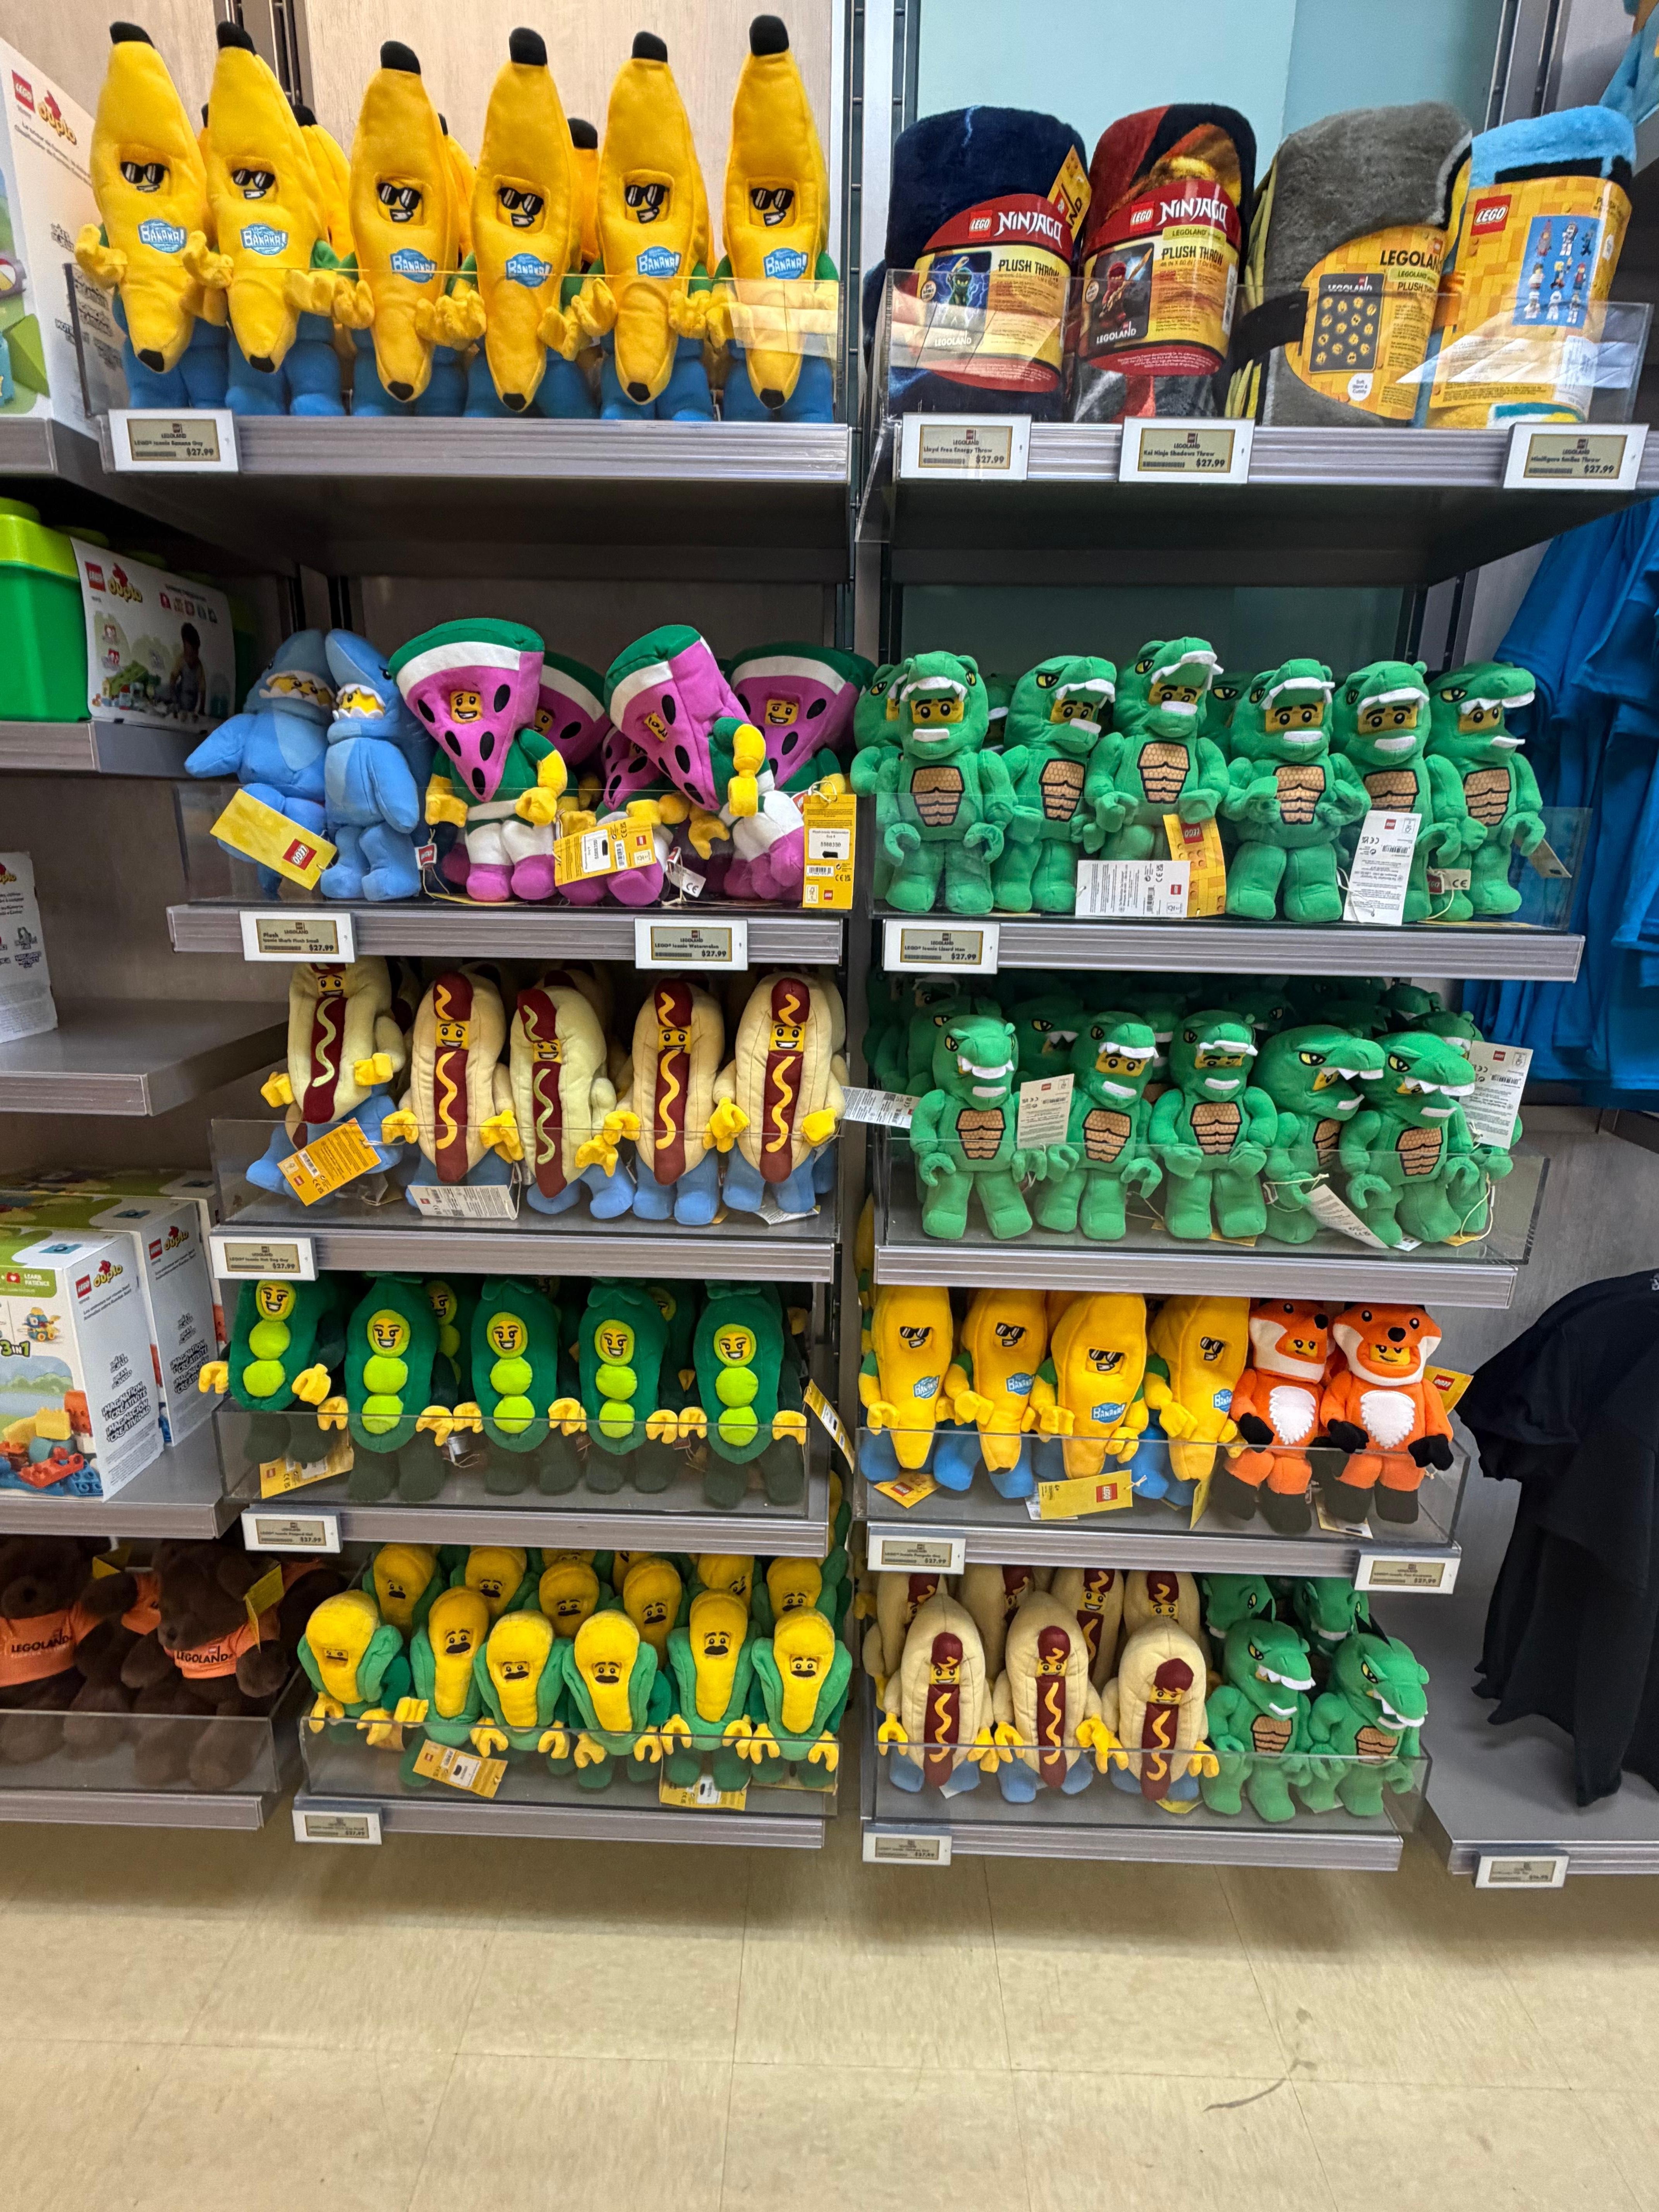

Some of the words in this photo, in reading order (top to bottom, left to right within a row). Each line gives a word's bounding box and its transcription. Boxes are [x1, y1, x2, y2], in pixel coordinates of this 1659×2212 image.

[1131, 209, 1153, 225] LEGO
[1156, 198, 1228, 232] NINJAGO
[1475, 205, 1508, 225] LEGO
[243, 230, 287, 249] BANANA!
[970, 218, 991, 231] LEGO
[993, 211, 1063, 249] NINJAGO
[639, 252, 680, 272] BANANA!
[766, 253, 807, 275] BANANA!
[1162, 246, 1196, 261] PLUSH
[1199, 246, 1224, 266] THROW
[998, 259, 1032, 273] PLUSH
[1397, 282, 1423, 291] PLUSH
[934, 330, 972, 347] LEGOLAND
[1096, 321, 1137, 345] LEGOLAND
[186, 448, 213, 457] $27.99
[976, 455, 1004, 464] $27.99
[1196, 458, 1225, 468] $27.99
[1584, 464, 1614, 474] $27.99
[1183, 827, 1200, 838] LEGO
[292, 845, 309, 866] LEGO
[702, 949, 726, 957] $27.99
[951, 953, 976, 961] $27.99
[94, 1264, 123, 1287] duplo
[101, 1381, 143, 1417] IMAGINATION
[12, 1628, 69, 1652] LEGOLAND
[176, 1645, 228, 1663] LEGOLAND
